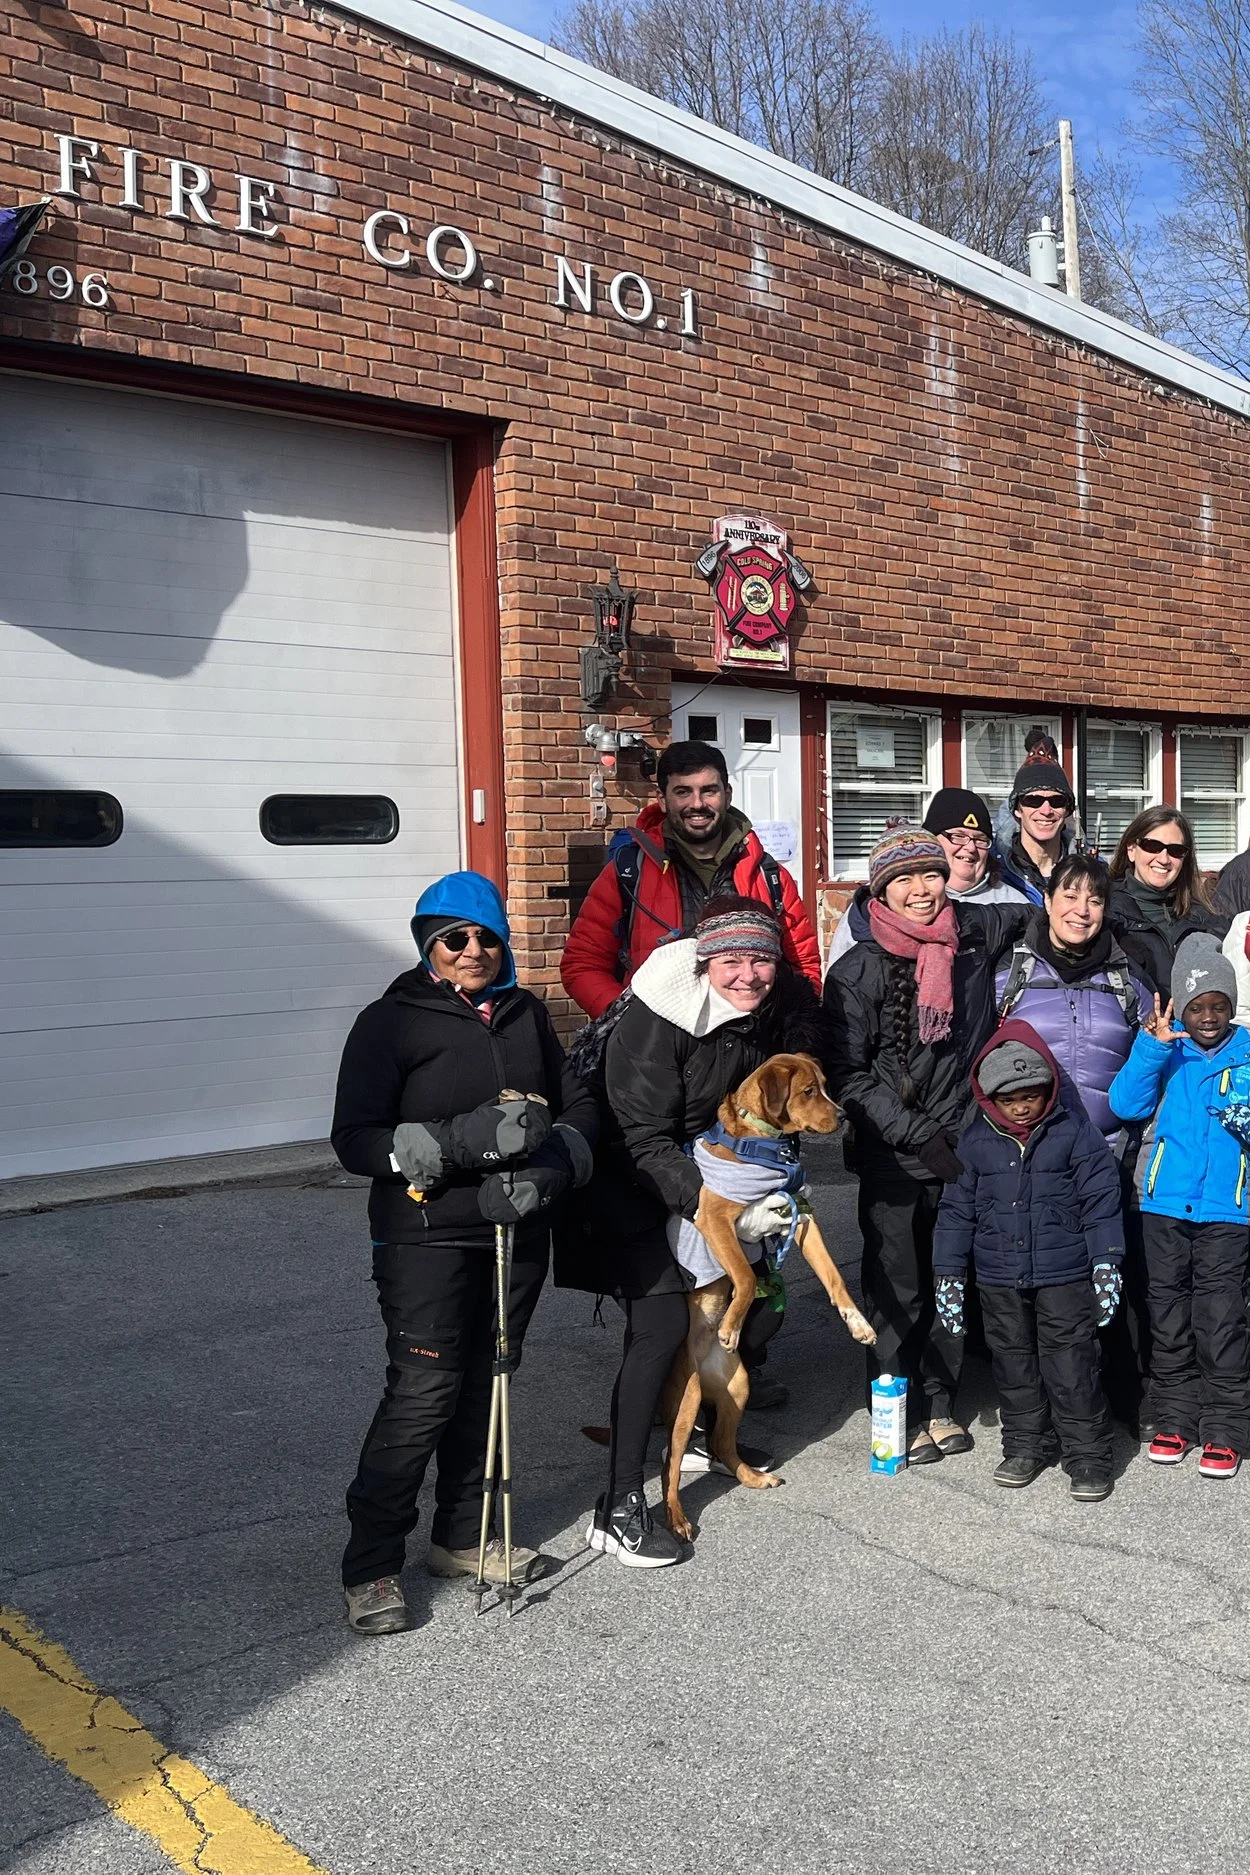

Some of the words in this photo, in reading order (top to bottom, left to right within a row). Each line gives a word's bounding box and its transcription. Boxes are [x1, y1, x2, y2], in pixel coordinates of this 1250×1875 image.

[53, 132, 280, 238] FIRE
[363, 210, 495, 291] CO.
[0, 259, 109, 307] 896
[724, 528, 780, 544] ANNIVERSARY
[702, 550, 717, 566] 1896
[737, 557, 751, 567] COLD
[752, 556, 773, 571] SPRING
[752, 621, 772, 629] COMPANY
